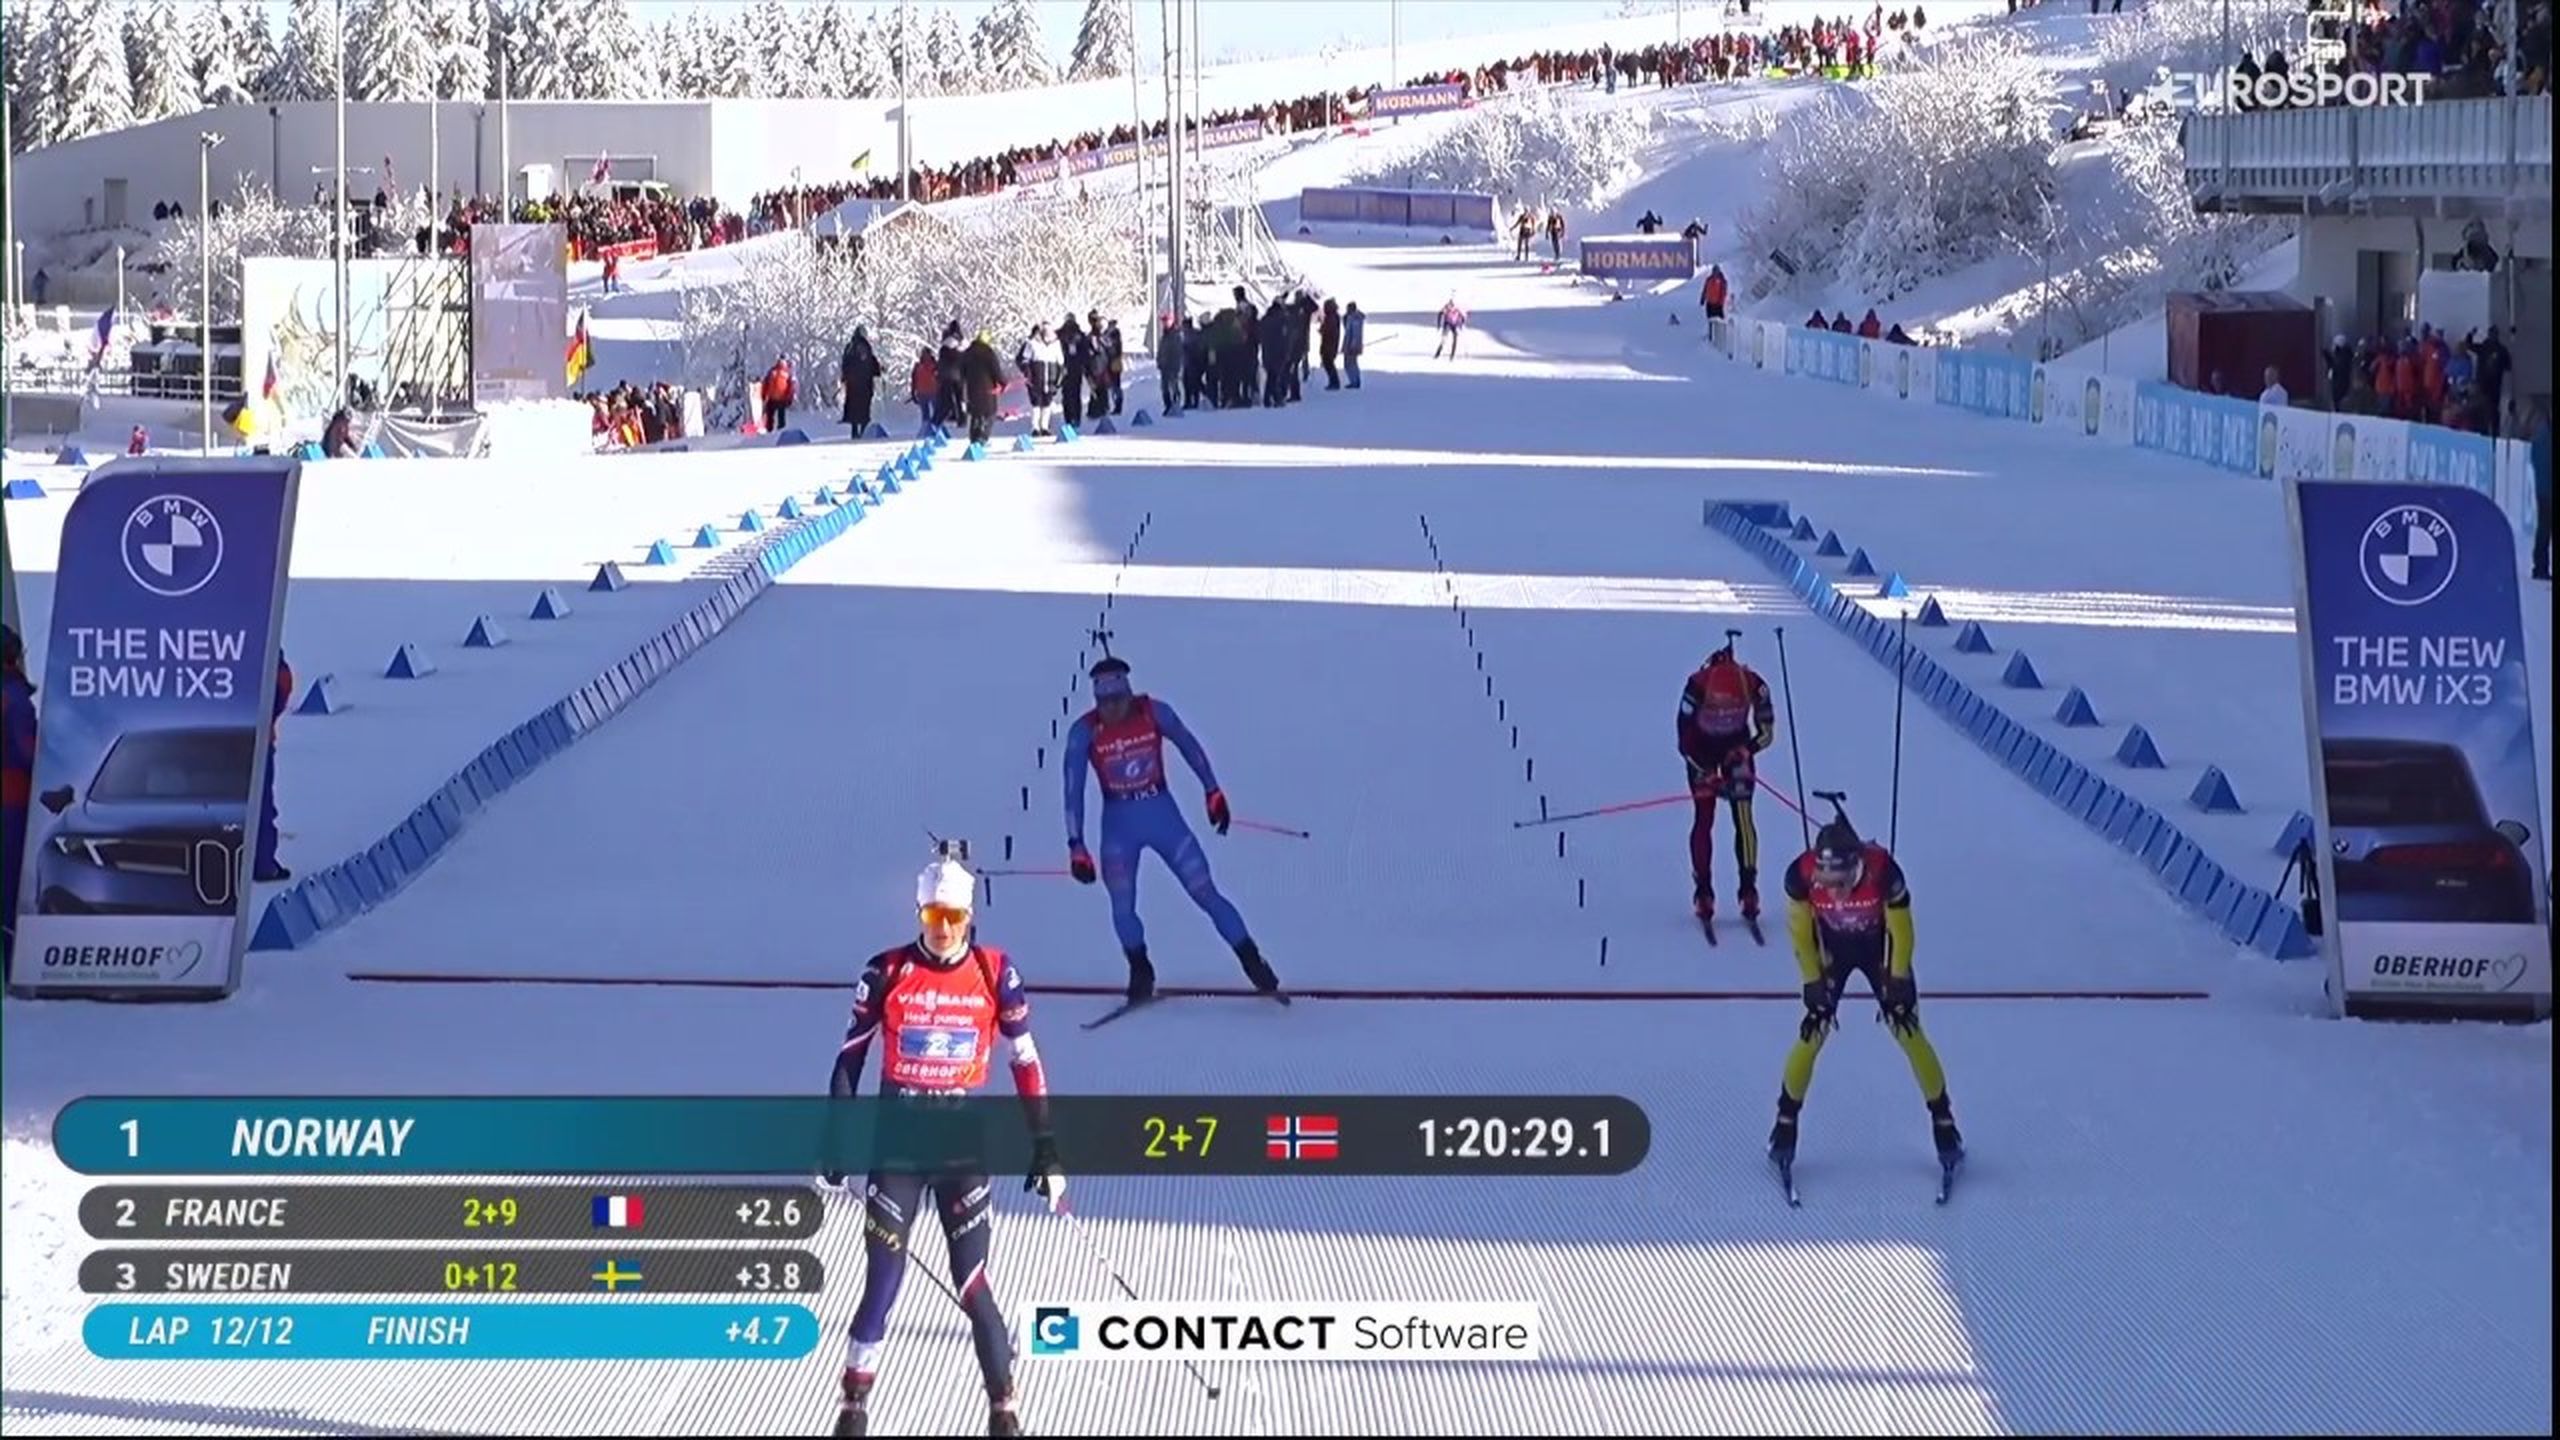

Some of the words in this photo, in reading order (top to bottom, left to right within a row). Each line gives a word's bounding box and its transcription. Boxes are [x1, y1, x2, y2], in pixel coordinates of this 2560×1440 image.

[136, 500, 209, 528] BMW
[2375, 511, 2445, 538] BMW
[68, 628, 148, 660] THE
[159, 628, 246, 661] NEW
[2333, 636, 2409, 667] THE
[2420, 637, 2505, 668] NEW
[70, 666, 165, 697] BMW
[176, 667, 233, 699] iX3
[2334, 674, 2426, 705] BMW
[2436, 674, 2492, 705] iX3
[44, 945, 164, 968] OBERHOF
[2373, 954, 2489, 978] OBERHOF
[925, 1032, 953, 1057] 2
